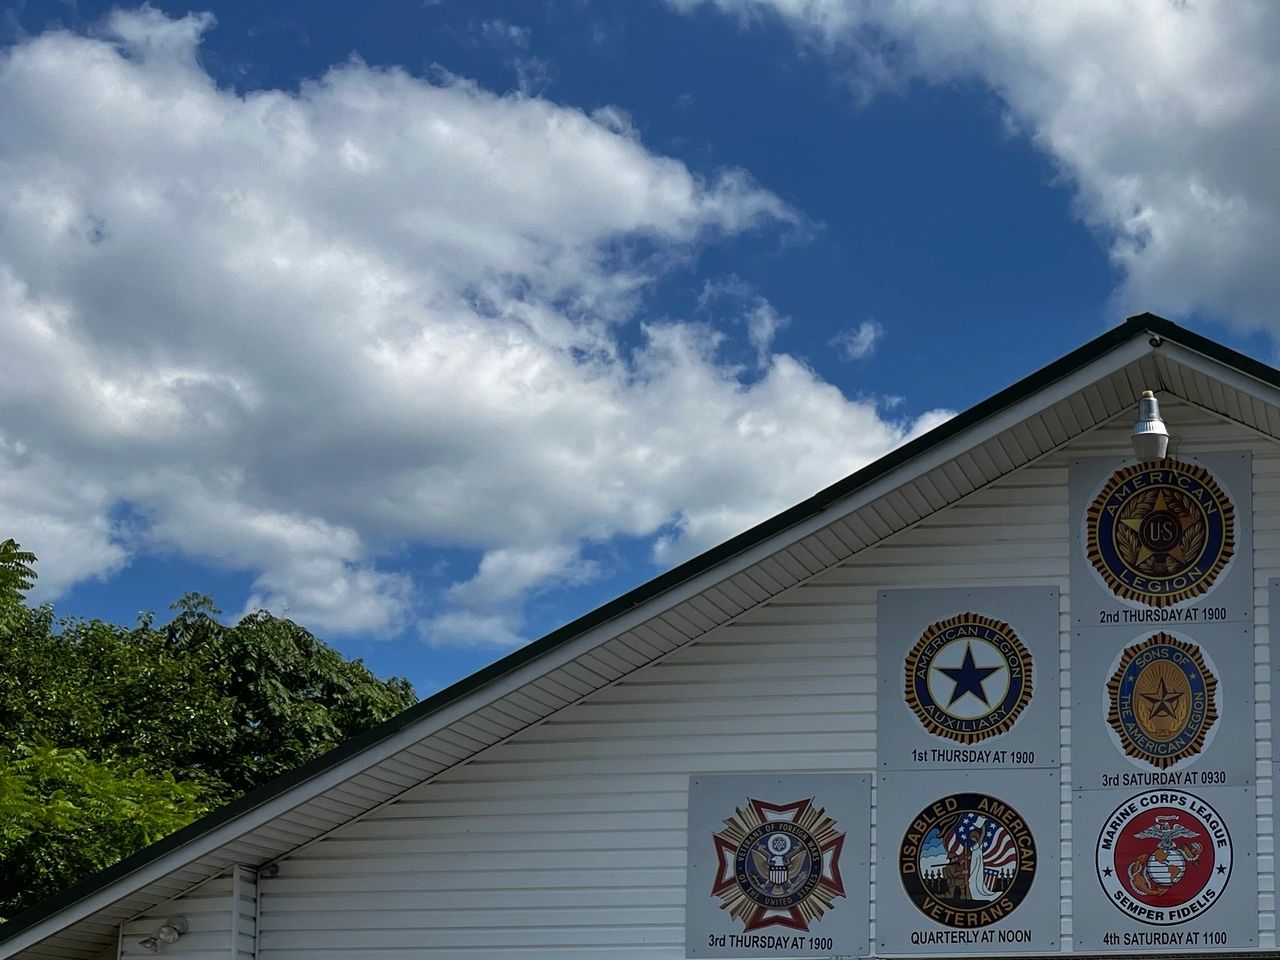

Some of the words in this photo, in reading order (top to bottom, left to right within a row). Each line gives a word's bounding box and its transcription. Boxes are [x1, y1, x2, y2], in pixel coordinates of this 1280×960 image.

[1106, 472, 1217, 517] AMERICAN
[1120, 567, 1203, 592] LEGION
[1100, 610, 1119, 623] 2nd
[1123, 608, 1183, 622] THURSDAY
[1185, 608, 1198, 620] AT
[1202, 607, 1226, 620] 1900
[917, 626, 978, 680] AMERICAN
[984, 629, 1021, 678] LEGION
[1136, 648, 1169, 668] SONS
[1173, 652, 1190, 665] OF
[924, 704, 1007, 731] AUXILIARY
[1121, 695, 1132, 718] THE
[1184, 692, 1204, 736] LEGION
[1126, 723, 1186, 754] AMERICAN
[912, 749, 927, 761] 1st
[931, 750, 993, 762] THURSDAY
[993, 750, 1007, 763] AT
[1010, 751, 1034, 764] 1900
[1102, 774, 1119, 786] 3rd
[1123, 772, 1182, 786] SATURDAY
[1184, 772, 1198, 784] AT
[1201, 771, 1226, 784] 0930
[902, 798, 958, 873] DISABLED
[977, 798, 1034, 872] AMERICAN
[1102, 803, 1138, 850] MARINE
[1140, 794, 1188, 808] CORPS
[1189, 801, 1228, 848] LEAGUE
[737, 826, 763, 862] VETERANS
[765, 824, 775, 832] OF
[779, 823, 808, 840] FOREIGN
[807, 839, 820, 862] WARS
[739, 874, 747, 884] OF
[746, 886, 760, 900] THE
[764, 897, 792, 905] UNITED
[799, 874, 818, 898] STATES
[922, 897, 1014, 926] VETERANS
[1114, 890, 1164, 921] SEMPER
[1169, 888, 1216, 921] FIDELIS
[708, 934, 726, 947] 3rd
[729, 935, 790, 949] THURSDAY
[790, 936, 805, 949] AT
[809, 937, 833, 950] 1900
[911, 930, 978, 944] QUARTERLY
[981, 930, 995, 943] AT
[999, 930, 1031, 942] NOON
[1103, 933, 1120, 945] 4th
[1124, 932, 1184, 945] SATURDAY
[1186, 932, 1200, 944] AT
[1203, 932, 1227, 944] 1100
